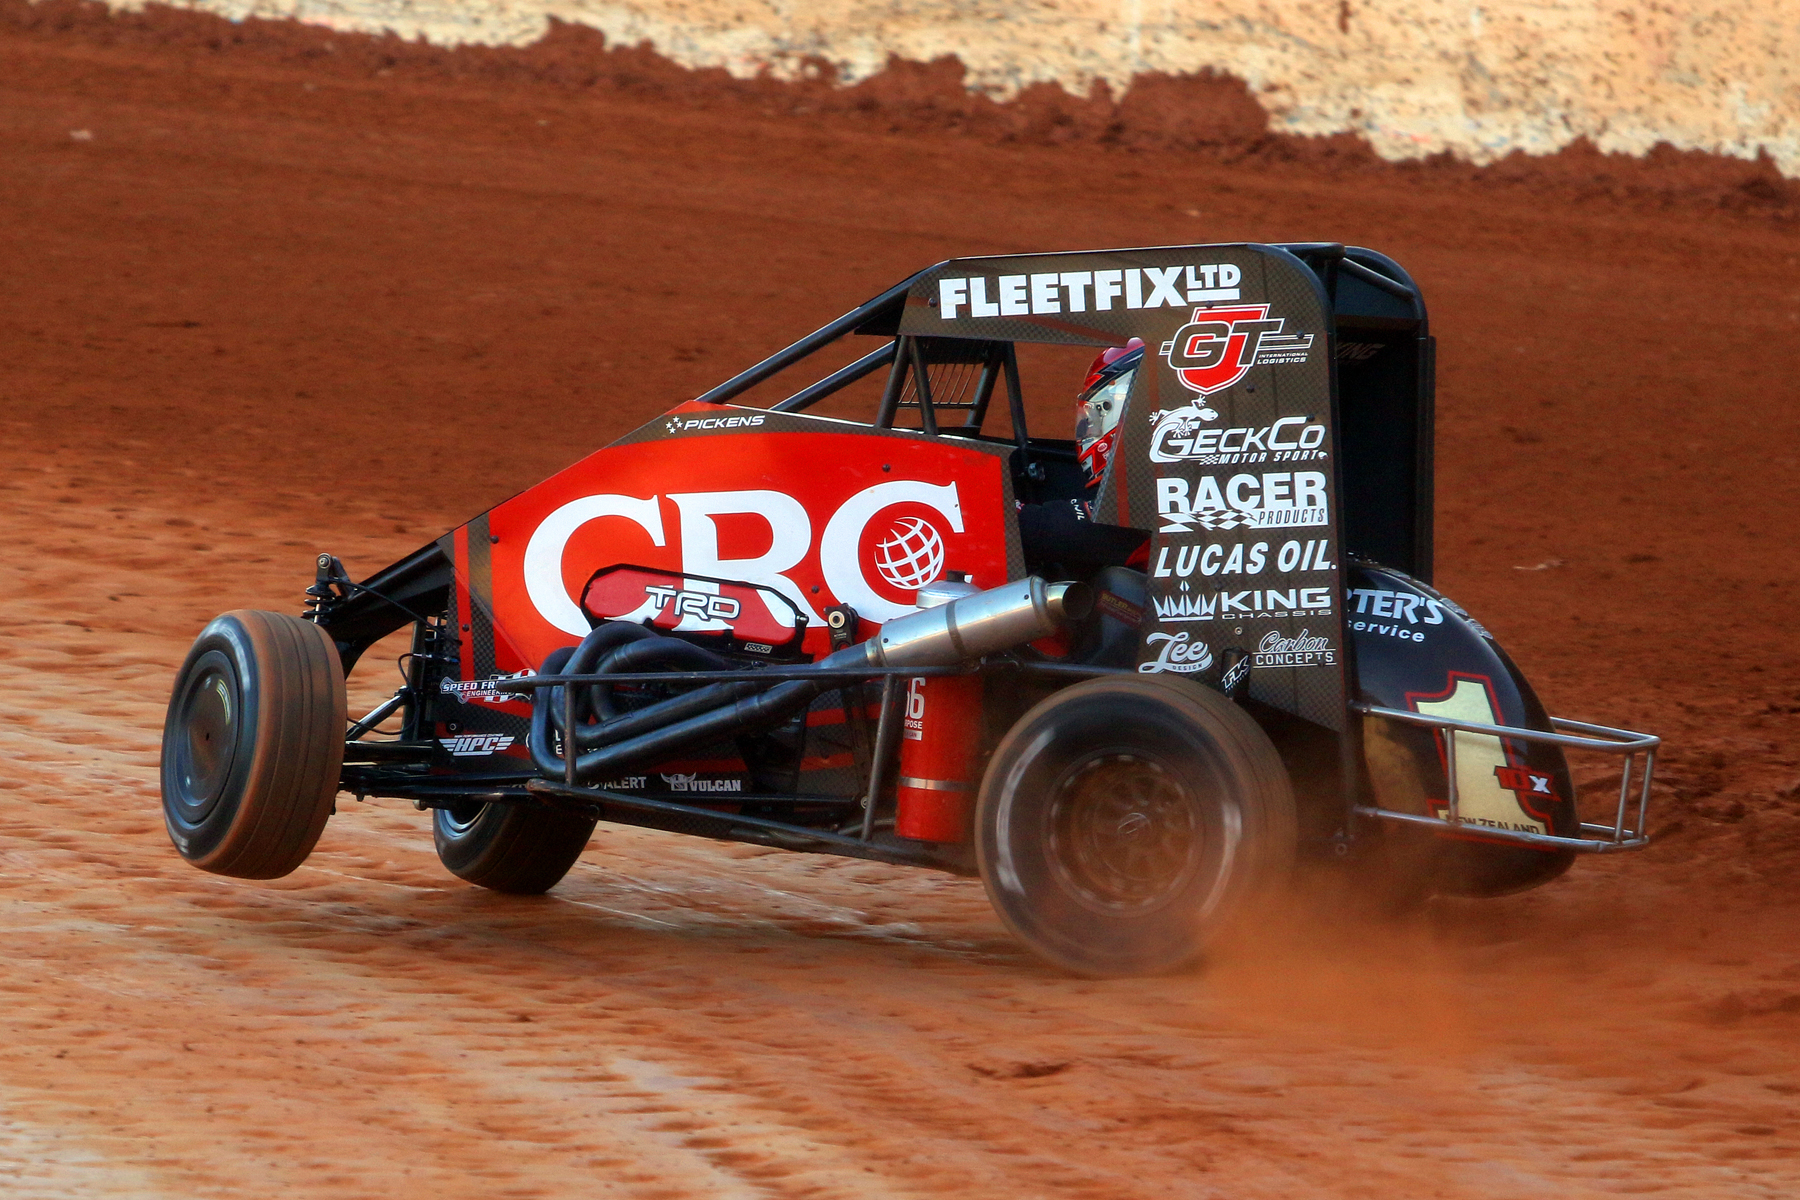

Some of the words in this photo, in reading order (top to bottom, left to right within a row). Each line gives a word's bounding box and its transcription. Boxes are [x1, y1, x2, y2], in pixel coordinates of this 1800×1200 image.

[938, 265, 1187, 320] FLEETFIX
[1186, 263, 1242, 290] LTD
[1256, 356, 1308, 365] LOGISTICS
[1258, 351, 1309, 359] INTERNATIONAL
[683, 415, 766, 431] PICKENS
[1217, 451, 1268, 465] MOTOR
[1273, 449, 1319, 462] SPORT
[1156, 471, 1329, 513] RACER
[1258, 508, 1326, 525] PRODUCTS
[523, 480, 965, 639] CRC
[1153, 542, 1269, 578] LUCAS
[644, 585, 741, 622] TRD
[1221, 587, 1332, 612] KING
[1347, 588, 1444, 625] TER'S
[1222, 609, 1332, 619] CHASSIS
[1258, 628, 1329, 654] Carbon
[1255, 651, 1335, 666] CONCEPTS
[1172, 662, 1203, 672] DESIGN
[442, 682, 478, 692] SPEED
[453, 736, 502, 752] HPC
[690, 779, 742, 792] VULCAN
